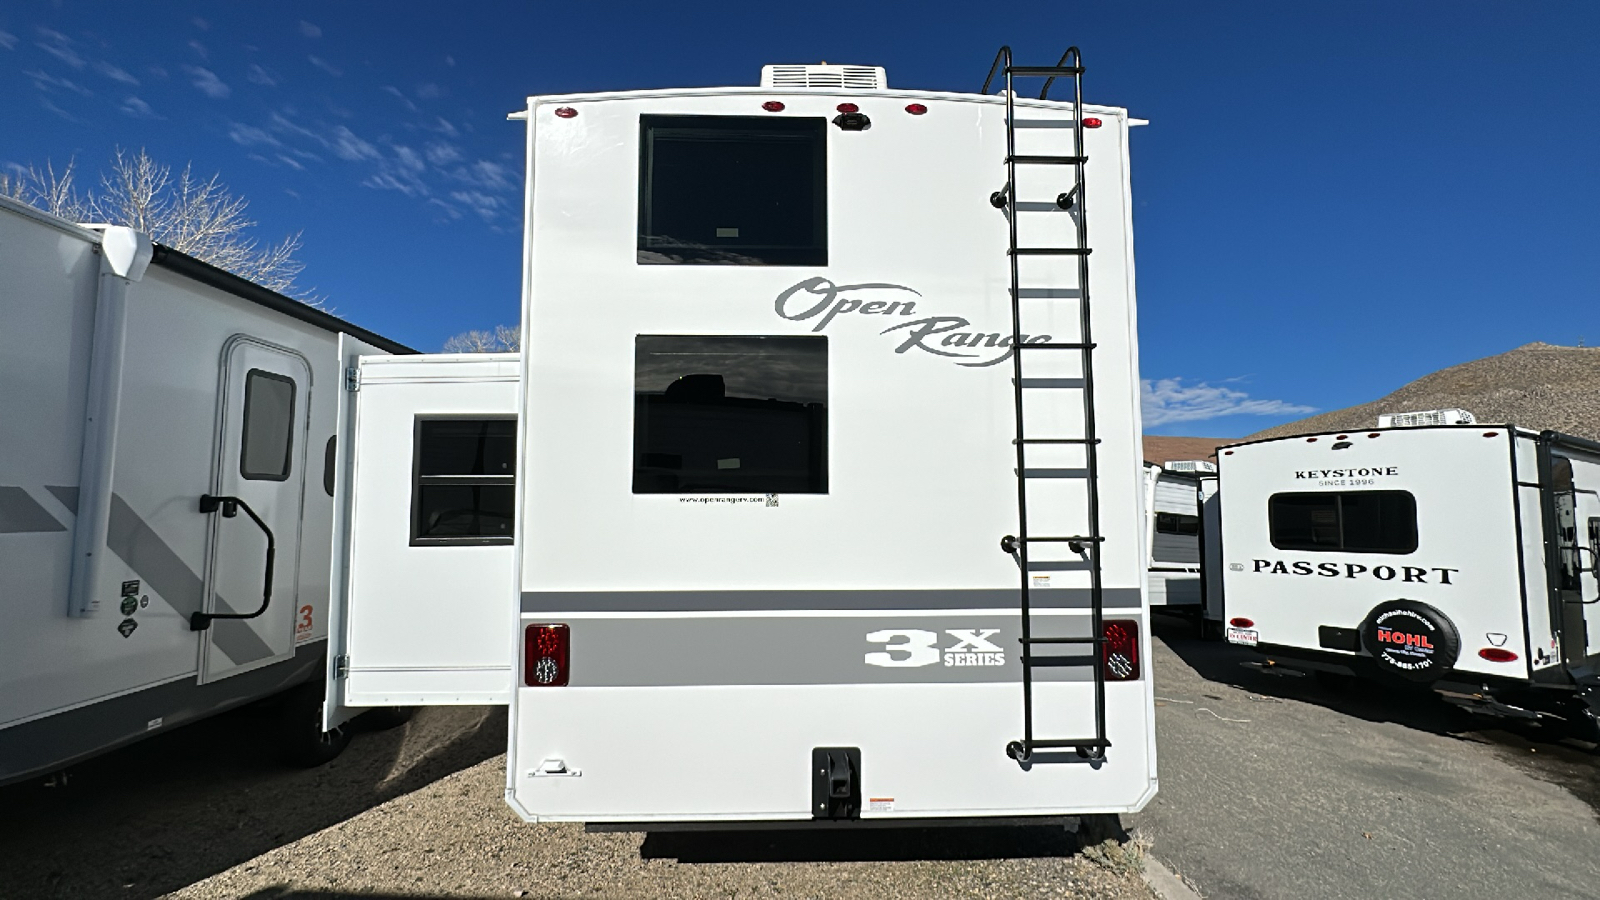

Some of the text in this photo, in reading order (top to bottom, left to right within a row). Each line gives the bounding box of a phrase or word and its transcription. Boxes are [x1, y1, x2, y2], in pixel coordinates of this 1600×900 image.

[775, 277, 922, 332] Open
[880, 316, 1053, 368] Range
[1295, 466, 1399, 479] KEYSTONE
[1318, 478, 1375, 487] SINCE 1996
[680, 497, 765, 505] www.openrangerv.com
[1252, 559, 1459, 585] PASSPORT
[299, 604, 313, 629] 3
[1377, 629, 1434, 649] HOHL
[944, 653, 1006, 667] SERIES
